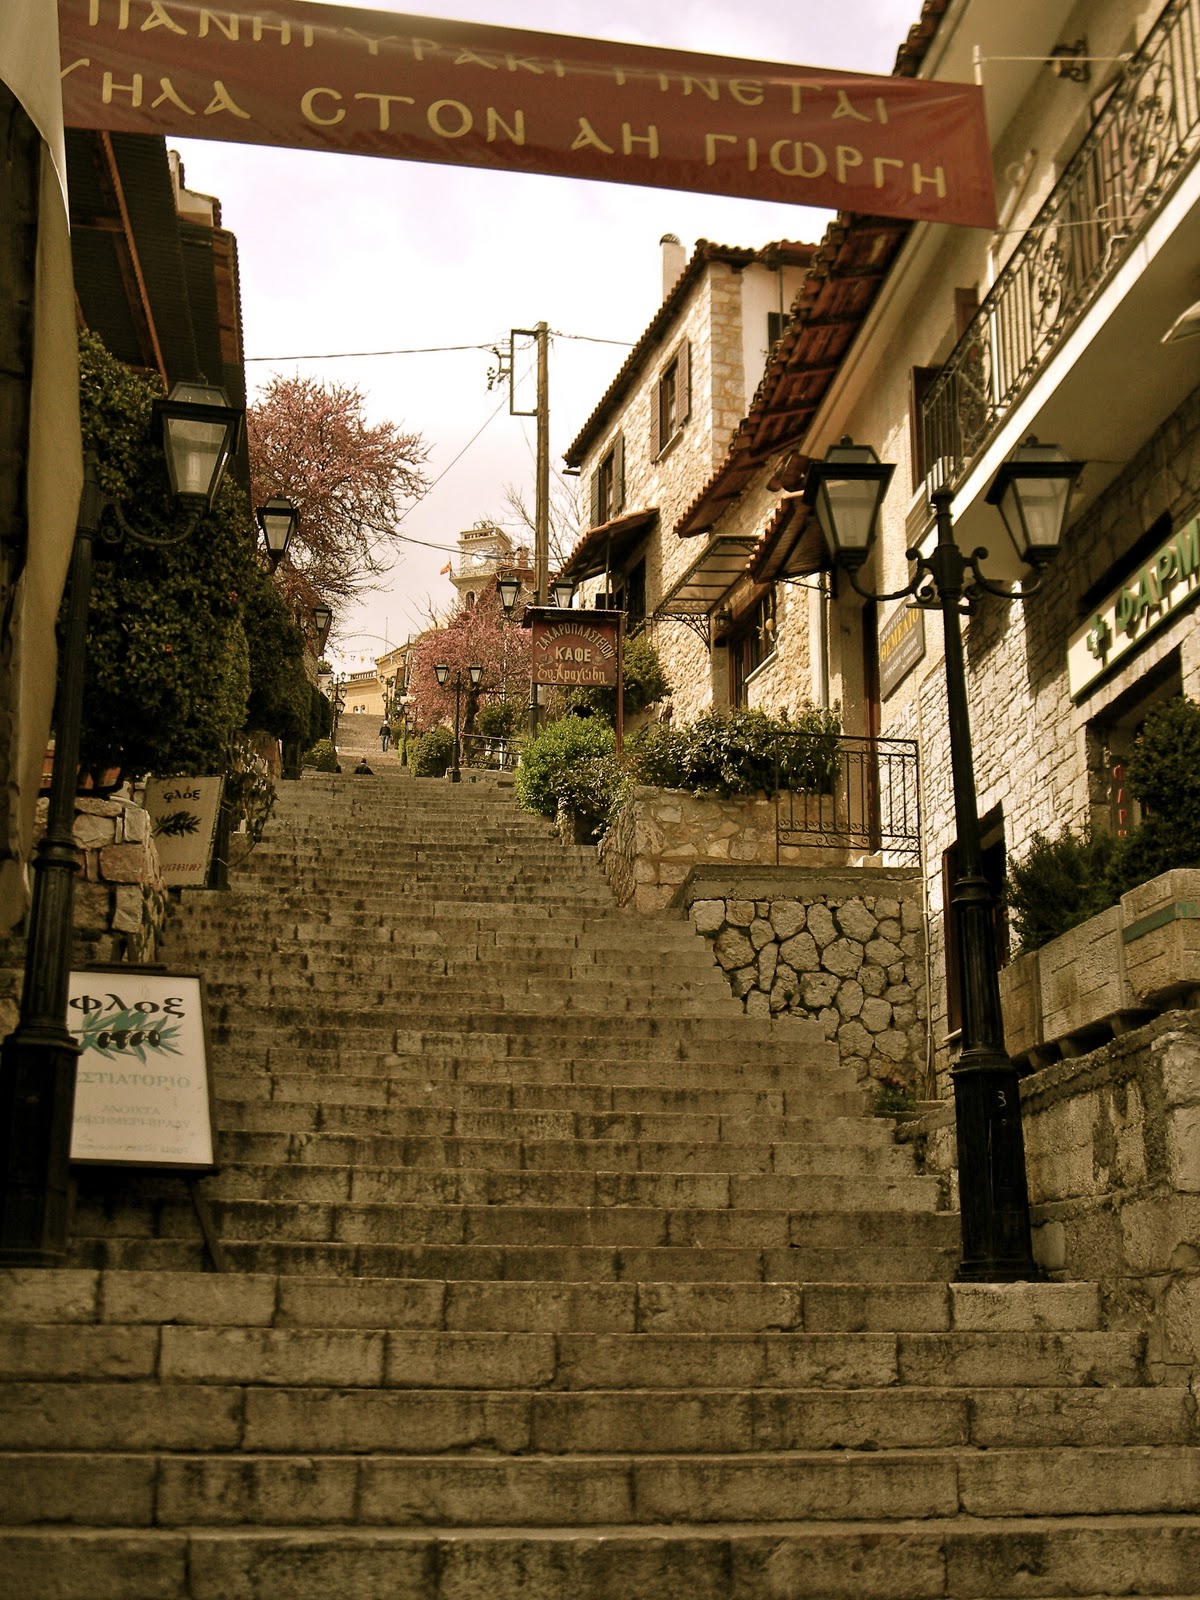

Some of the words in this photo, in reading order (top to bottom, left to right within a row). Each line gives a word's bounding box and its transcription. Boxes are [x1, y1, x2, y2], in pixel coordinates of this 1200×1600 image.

[571, 117, 660, 159] ΑΗ
[535, 622, 615, 660] ΖΑΧΑΡΟΠΛΑΣΤΕΙΟΝ
[555, 646, 592, 663] ΚΑΦΕ
